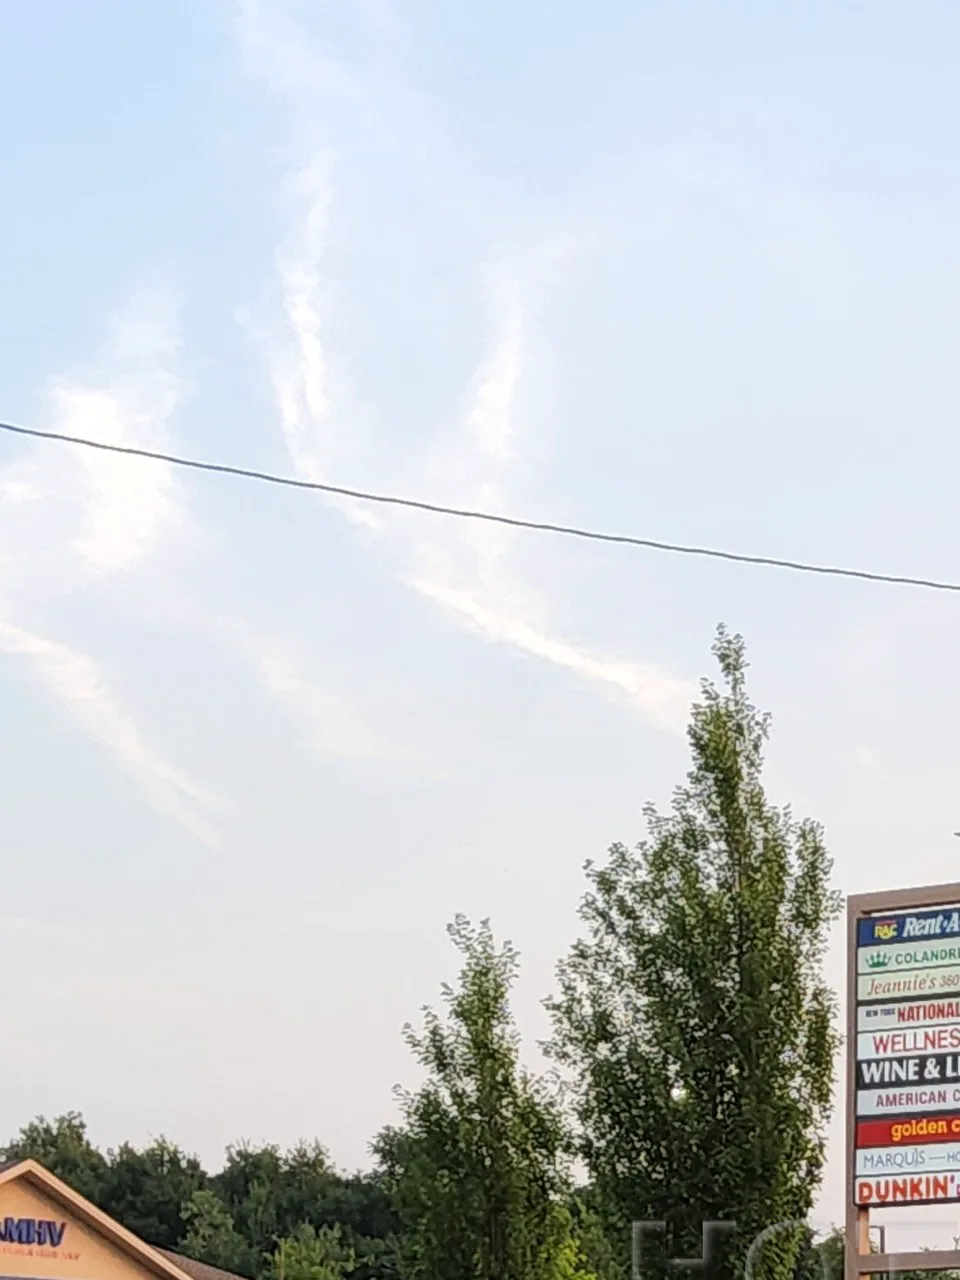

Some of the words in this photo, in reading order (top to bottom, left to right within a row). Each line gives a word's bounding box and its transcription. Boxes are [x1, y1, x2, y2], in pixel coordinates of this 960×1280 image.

[867, 974, 937, 996] Jeannie's
[861, 1059, 919, 1083] WINE
[923, 1058, 941, 1079] &
[876, 1090, 947, 1108] AMERICAN
[891, 1119, 947, 1141] golden
[863, 1149, 925, 1168] MARQUIS
[858, 1175, 955, 1203] DUNKIN'
